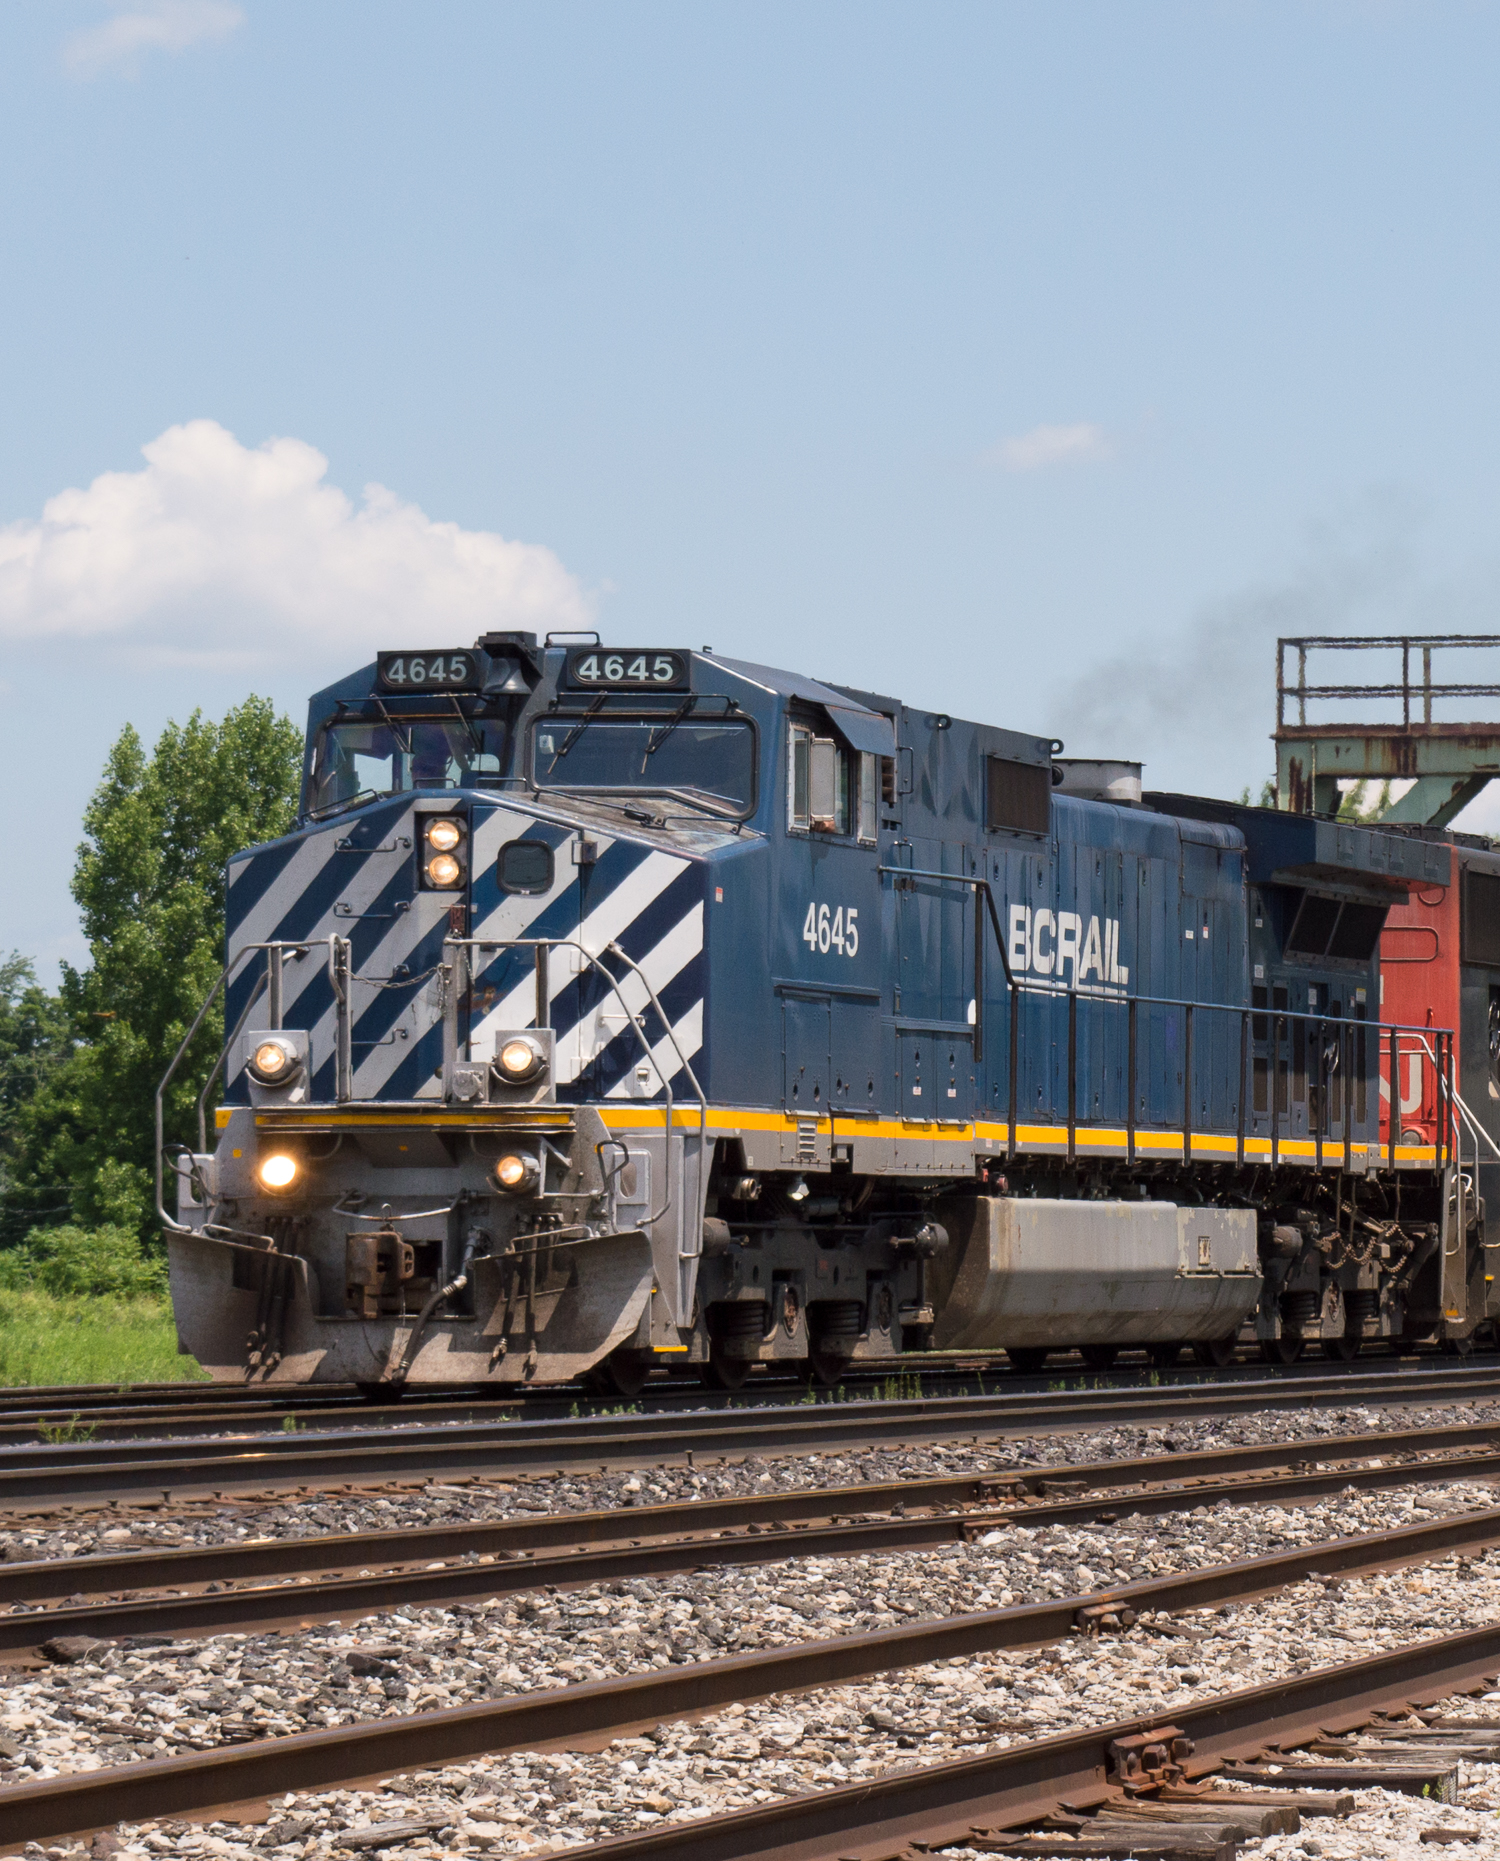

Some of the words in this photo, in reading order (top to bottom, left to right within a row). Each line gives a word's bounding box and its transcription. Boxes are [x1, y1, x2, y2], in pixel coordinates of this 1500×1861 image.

[388, 656, 467, 683] 4645
[579, 655, 674, 681] 4645
[803, 902, 859, 957] 4645
